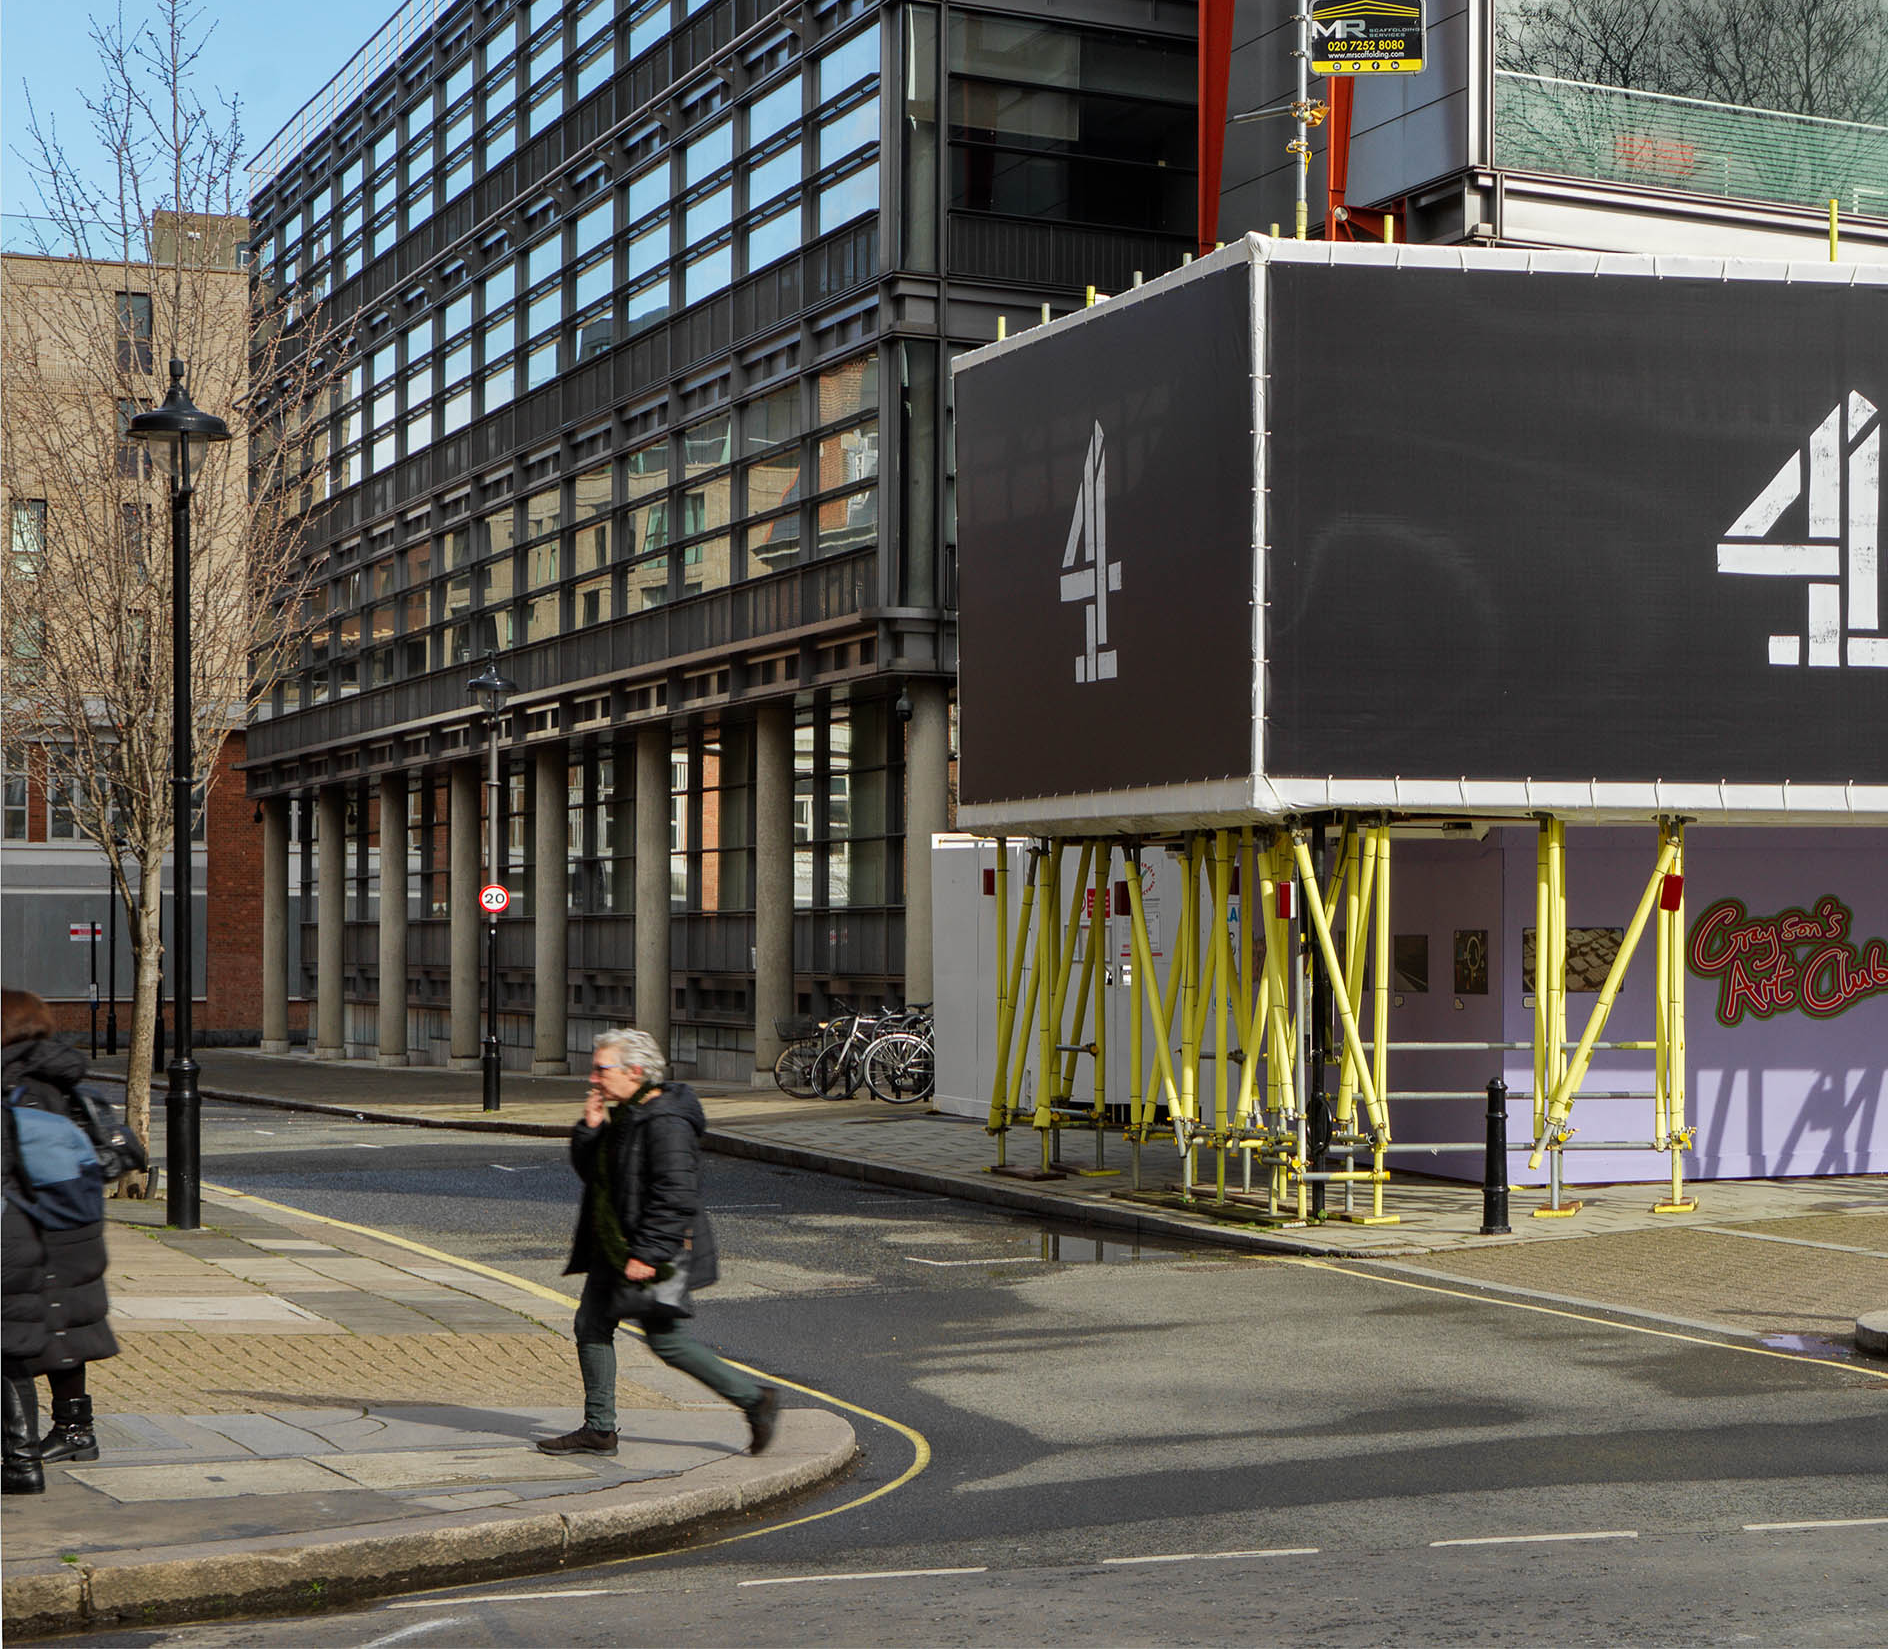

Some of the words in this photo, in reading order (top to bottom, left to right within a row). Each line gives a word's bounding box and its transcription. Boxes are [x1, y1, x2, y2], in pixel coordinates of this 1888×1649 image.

[1311, 20, 1367, 39] MR
[1328, 41, 1347, 51] 020
[1350, 41, 1376, 51] 7252
[1379, 40, 1404, 50] 8080
[1328, 51, 1404, 59] www.mrscaffolding.com
[1060, 419, 1122, 683] 4
[485, 893, 505, 904] 20
[1726, 954, 1794, 1018] Art
